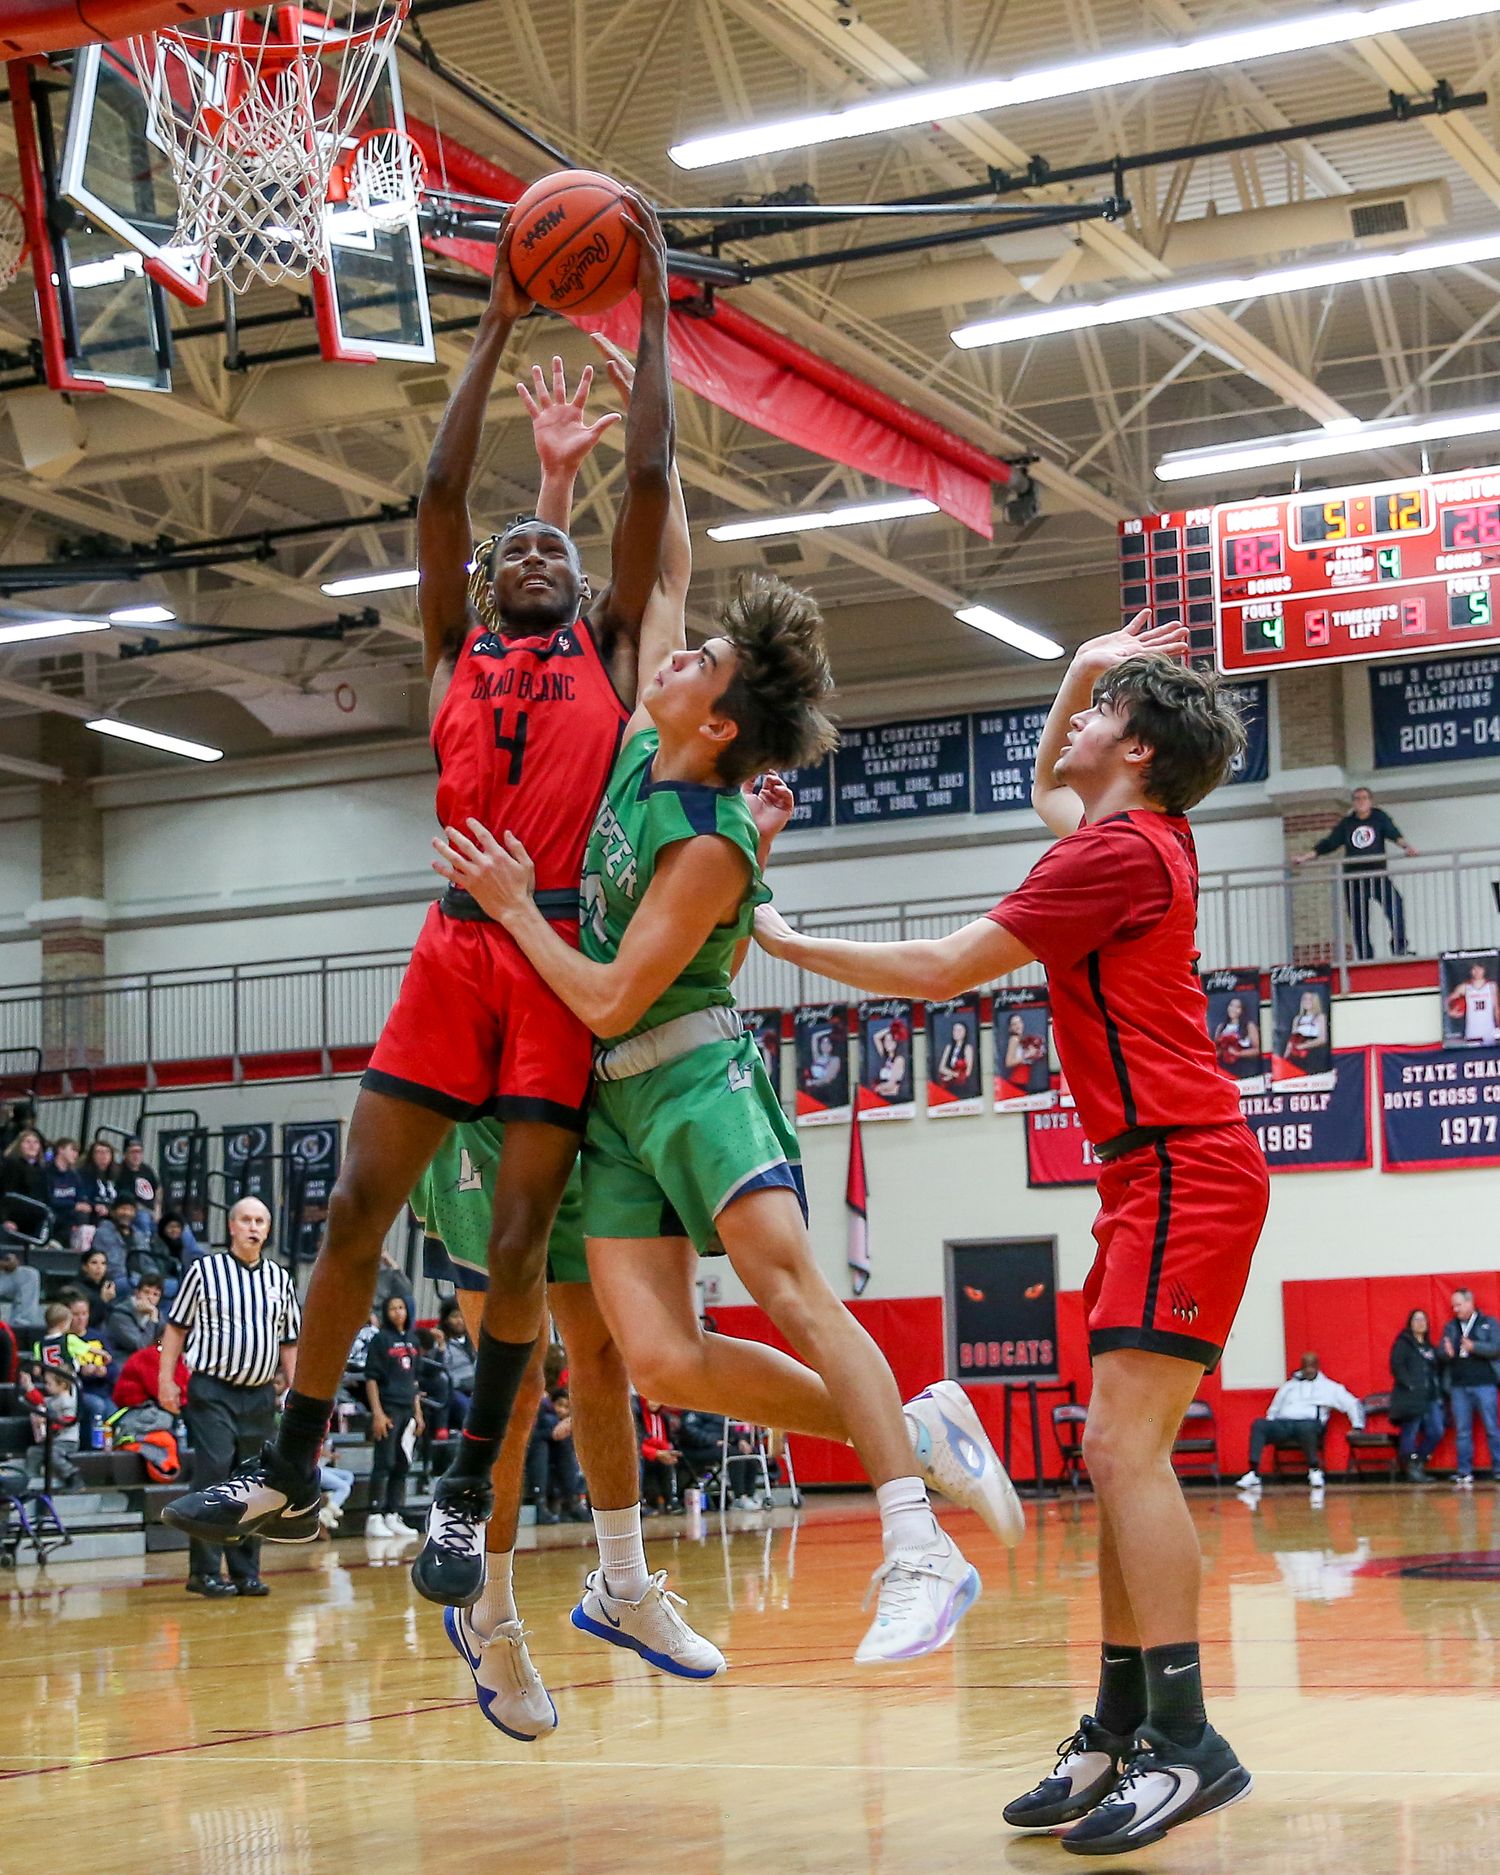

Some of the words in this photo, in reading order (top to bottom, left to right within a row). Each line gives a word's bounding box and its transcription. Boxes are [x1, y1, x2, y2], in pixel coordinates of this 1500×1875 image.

[548, 233, 610, 301] Rawlings
[1226, 507, 1280, 532] HOME
[1453, 505, 1500, 546] 26
[1234, 533, 1282, 575] 82
[1325, 556, 1375, 576] PERIOD
[1379, 547, 1400, 579] 4
[1435, 551, 1483, 571] BONUS
[1247, 576, 1293, 595] BONUS
[1447, 575, 1491, 595] FOULS
[1241, 602, 1284, 620] FOULS
[1331, 604, 1399, 627] TIMEOUTS
[1405, 601, 1422, 632] 3
[1468, 591, 1490, 624] 5
[1262, 618, 1283, 648] 4
[1307, 613, 1325, 643] 5
[1349, 622, 1381, 639] LEFT
[517, 671, 576, 702] BLANC
[1379, 669, 1404, 686] BIG
[1404, 675, 1494, 699] ALL-SPORTS
[1408, 691, 1491, 715] CHAMPIONS
[881, 721, 961, 743] CONFERENCE
[980, 718, 1003, 734] BIG
[1400, 715, 1500, 753] 2003-04
[493, 708, 528, 785] 4
[862, 739, 940, 761] ALL-SPORTS
[864, 754, 938, 775] CHAMPIONS
[1402, 1063, 1458, 1084] STATE
[1463, 1059, 1500, 1079] CHA
[1239, 1096, 1284, 1116] GIRLS
[1289, 1093, 1331, 1113] GOLF
[1383, 1090, 1424, 1110] BOYS
[1429, 1086, 1478, 1106] CROSS
[1034, 1112, 1068, 1130] BOYS
[1441, 1115, 1498, 1146] 1977
[1257, 1123, 1313, 1152] 1985
[42, 1344, 65, 1368] 5
[959, 1338, 1053, 1368] BOBCATS
